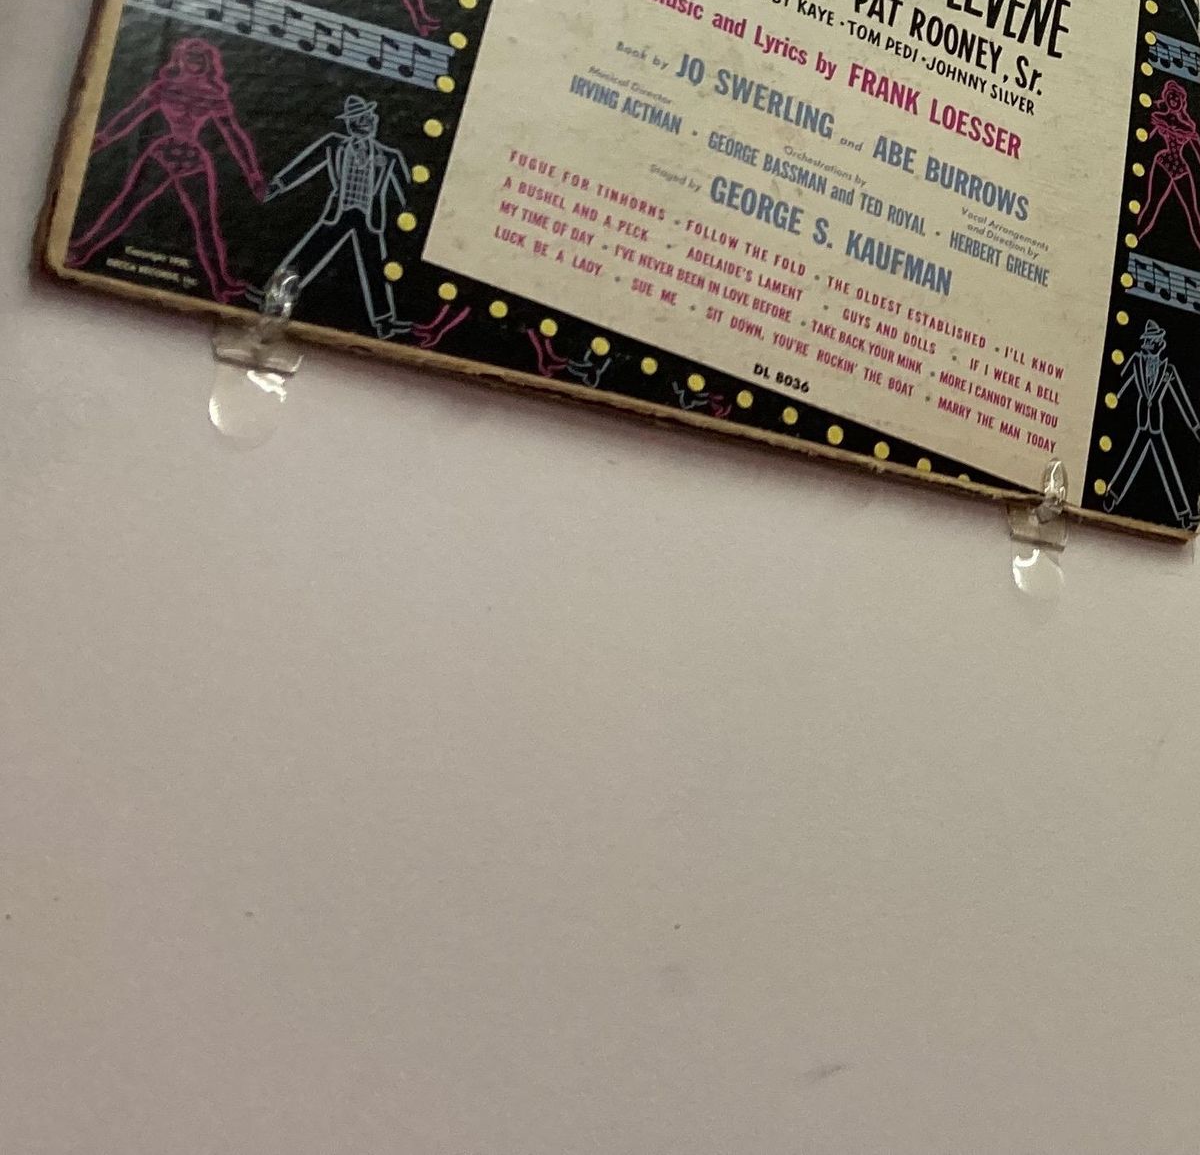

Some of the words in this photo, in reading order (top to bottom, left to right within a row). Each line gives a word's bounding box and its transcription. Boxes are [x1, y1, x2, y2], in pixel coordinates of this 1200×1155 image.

[569, 74, 620, 110] IRVING
[621, 96, 683, 135] ACTMAN
[712, 12, 747, 39] and
[753, 25, 808, 66] Lyrics
[815, 51, 837, 81] by
[848, 62, 921, 116] FRANK
[929, 98, 1022, 159] LOESSER
[847, 19, 881, 47] TOM
[885, 36, 919, 63] PEDI
[926, 56, 988, 94] JOHNNY
[989, 83, 1035, 116] SILVER
[1014, 55, 1043, 96] Sr.
[676, 52, 706, 87] JO
[713, 68, 836, 140] SWERLING
[840, 136, 864, 153] and
[872, 134, 918, 175] ABE
[924, 155, 1030, 222] BURROWS
[708, 131, 760, 167] GEORGE
[762, 153, 828, 196] BASSMAN
[830, 185, 854, 207] and
[860, 192, 883, 218] TED
[887, 204, 926, 237] ROYAL
[509, 150, 557, 179] FUGUE
[562, 171, 590, 192] FOR
[597, 184, 666, 221] TINHORNS
[685, 219, 739, 252] FOLLOW
[745, 242, 768, 262] THE
[773, 253, 807, 277] FOLD
[827, 275, 851, 295] THE
[856, 287, 902, 316] OLDEST
[907, 307, 986, 350] ESTABLISHED
[1032, 357, 1065, 380] KNOW
[710, 176, 805, 236] GEORGE
[812, 217, 833, 249] S.
[845, 229, 952, 296] KAUFMAN
[950, 231, 1003, 268] HERBERT
[1006, 255, 1051, 288] GREENE
[988, 219, 1050, 253] Arrangements
[494, 225, 527, 247] LUCK
[572, 254, 603, 278] LADY
[631, 278, 654, 297] SUE
[863, 368, 884, 386] THE
[888, 377, 915, 398] BOAT
[938, 397, 971, 421] MARRY
[977, 411, 994, 430] THE
[1000, 421, 1021, 441] MAN
[1026, 431, 1057, 454] TODAY
[517, 181, 566, 210] BUSHEL
[572, 202, 598, 222] AND
[616, 220, 650, 242] PECK
[686, 246, 754, 284] ADELAIDE'S
[757, 273, 804, 303] LAMENT
[842, 307, 872, 330] GUYS
[876, 321, 898, 341] AND
[902, 330, 937, 355] DOLLS
[993, 368, 1021, 390] WERE
[1036, 383, 1061, 406] BELL
[521, 208, 549, 231] TIME
[570, 226, 595, 246] DAY
[638, 253, 674, 278] NEVER
[676, 267, 706, 291] BEEN
[723, 284, 750, 308] LOVE
[752, 297, 792, 324] BEFORE
[810, 319, 837, 342] TAKE
[838, 330, 865, 353] BACK
[867, 340, 894, 364] YOUR
[896, 352, 923, 375] MINK
[939, 371, 968, 394] MORE
[974, 385, 1012, 412] CANNOT
[1014, 399, 1038, 421] WISH
[754, 363, 771, 380] DL
[776, 371, 810, 394] 8036
